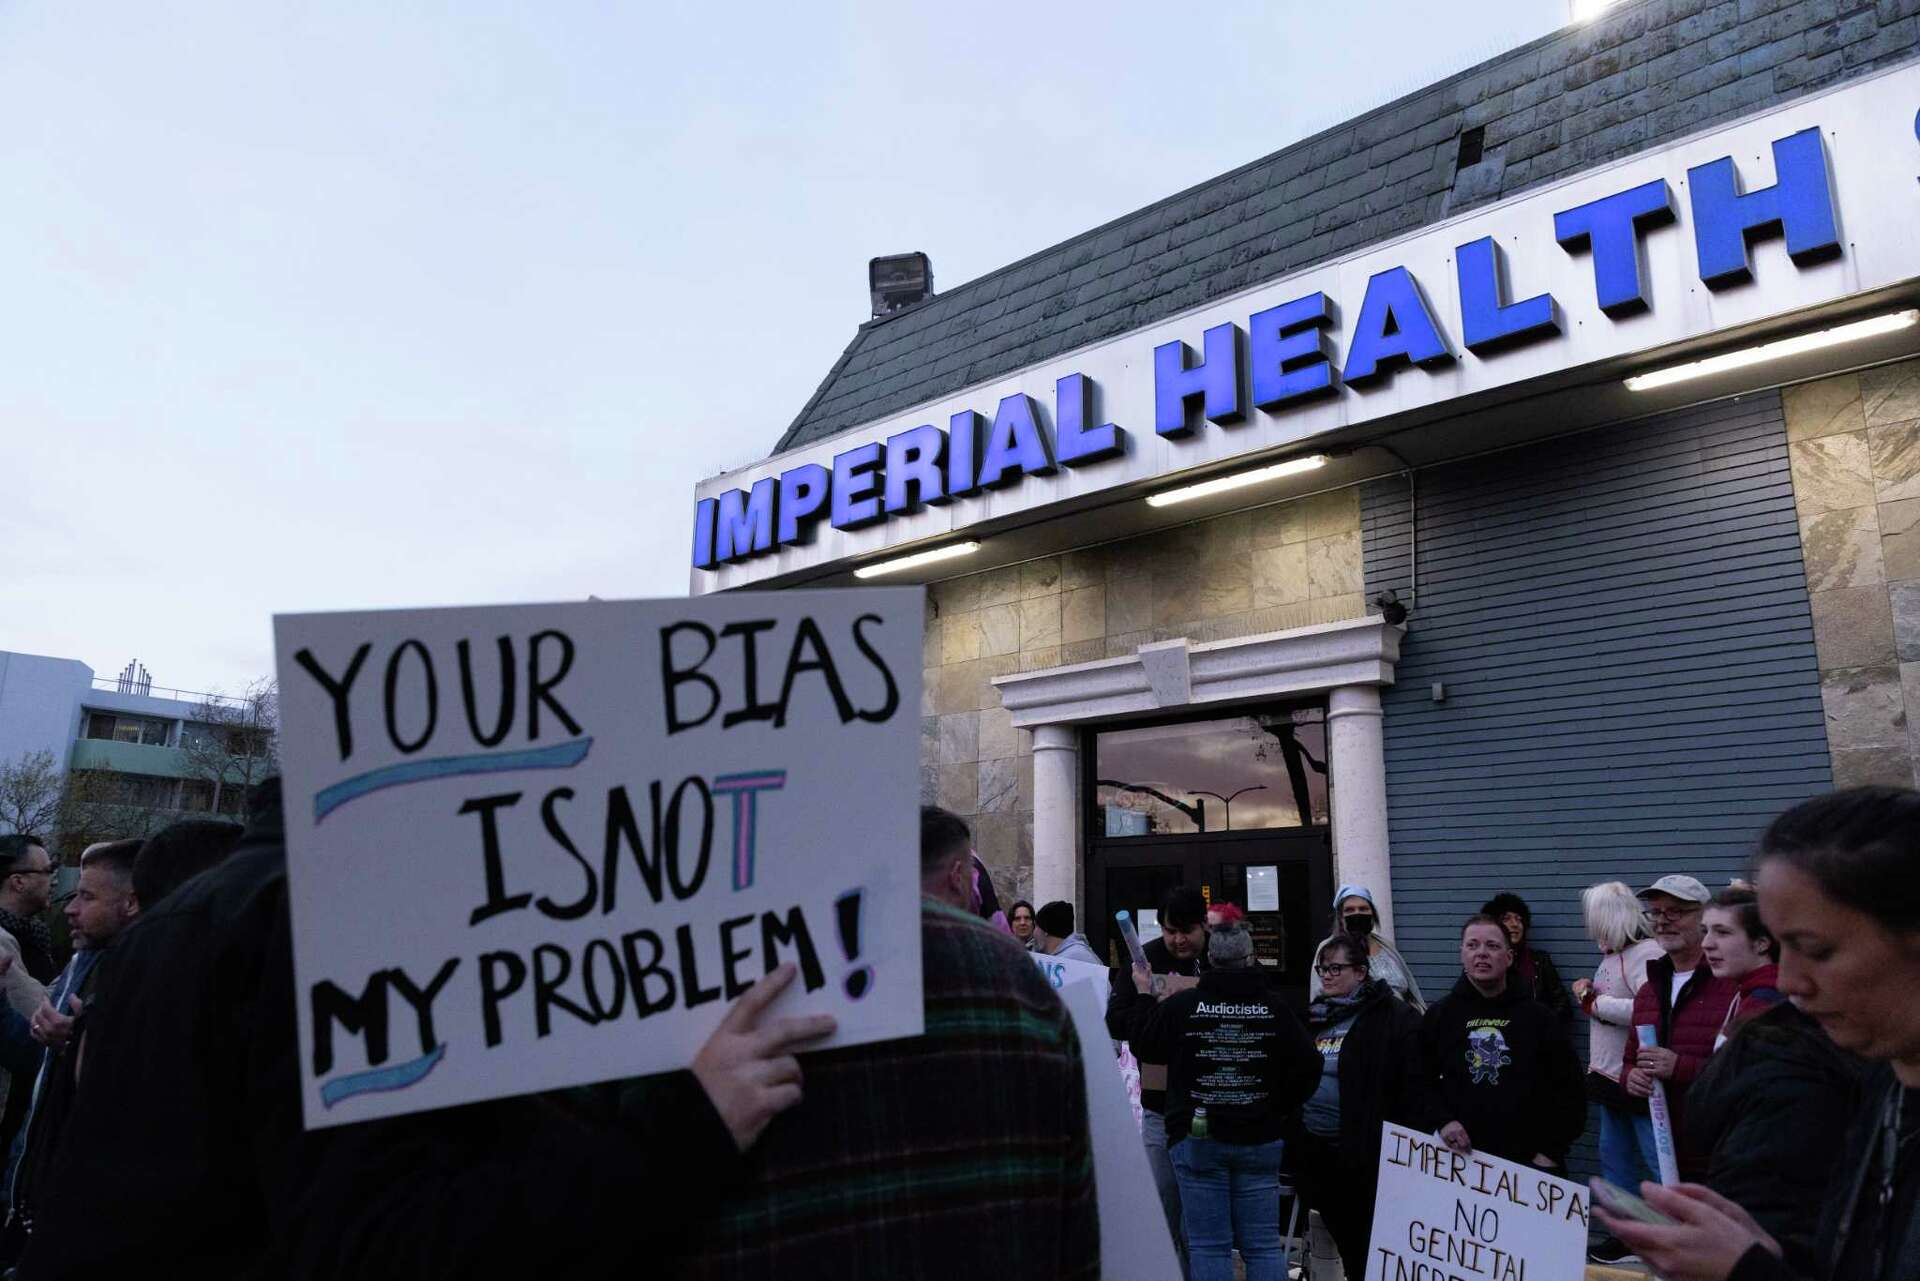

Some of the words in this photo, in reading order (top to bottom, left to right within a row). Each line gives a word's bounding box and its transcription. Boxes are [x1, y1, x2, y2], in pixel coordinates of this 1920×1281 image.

[693, 372, 1126, 570] IMPERIAL
[1154, 125, 1842, 438] HEALTH
[294, 629, 582, 761] YOUR
[660, 613, 900, 735] BIAS
[456, 786, 599, 926] IS
[602, 769, 786, 916] NOT
[310, 957, 461, 1077] MY
[1195, 1001, 1270, 1016] Audiotistic
[1387, 1131, 1529, 1206] IMPERIAL
[1536, 1180, 1588, 1227] SPA:
[1454, 1198, 1499, 1243] NO
[1409, 1220, 1526, 1281] GENITAL
